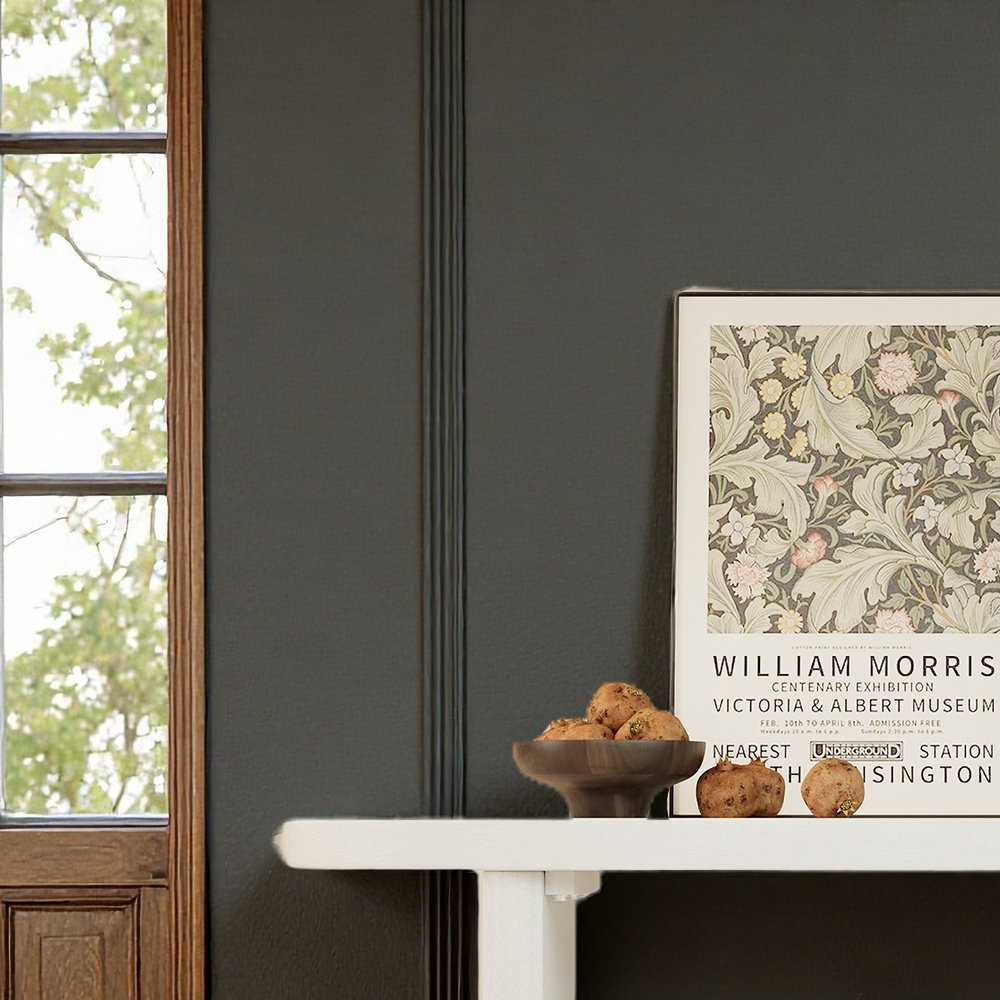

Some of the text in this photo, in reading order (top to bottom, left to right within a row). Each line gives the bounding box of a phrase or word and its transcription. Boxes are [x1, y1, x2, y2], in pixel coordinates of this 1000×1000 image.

[713, 655, 996, 677] WILLIAM MORRIS
[771, 682, 934, 693] CENTENARY EXHIBITION
[713, 698, 996, 713] VICTORIA & ALBERT MUSEUM
[760, 719, 780, 727] FEB.
[784, 719, 804, 727] 10th
[806, 719, 818, 727] TO
[820, 719, 845, 727] APRIL
[869, 719, 917, 727] ADMISSION
[920, 719, 941, 727] FREE
[713, 744, 791, 759] NEAREST
[919, 744, 994, 759] STATION
[862, 766, 992, 783] SINGTON
